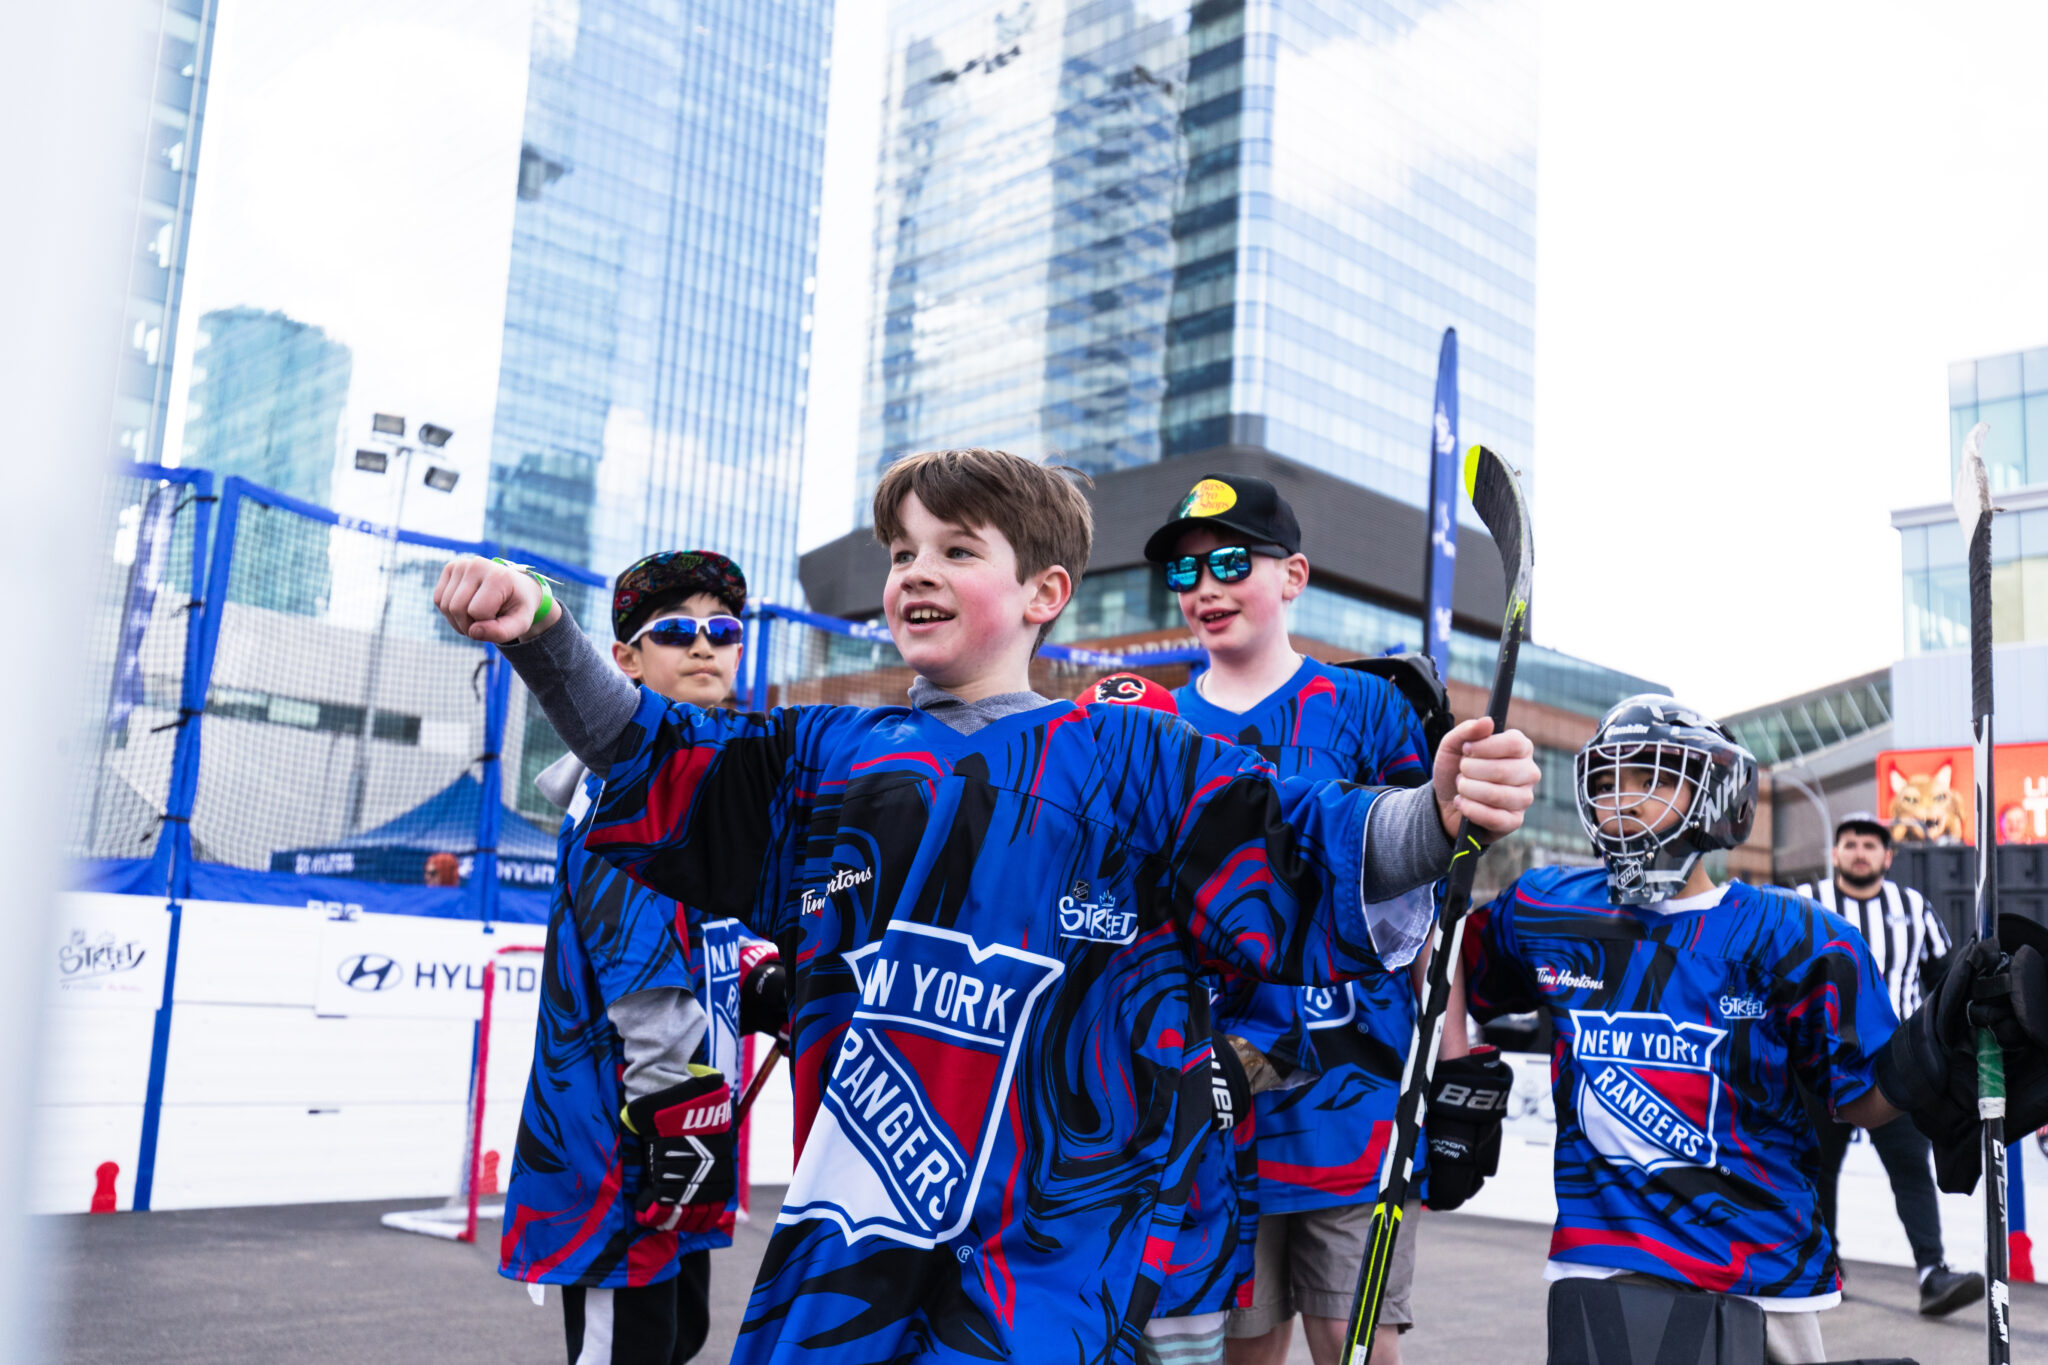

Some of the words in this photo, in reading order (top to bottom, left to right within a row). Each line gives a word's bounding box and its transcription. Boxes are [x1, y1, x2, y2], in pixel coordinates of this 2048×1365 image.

[1703, 752, 1749, 833] NHL
[801, 889, 826, 916] Tim
[826, 866, 873, 896] ortons
[1620, 866, 1638, 885] NHL
[1059, 896, 1138, 938] STREET
[913, 963, 1016, 1034] YORK
[1535, 967, 1556, 985] Tim
[1556, 968, 1604, 990] Hortons
[1719, 995, 1764, 1017] STREET
[1582, 1029, 1633, 1057] NEW
[831, 1026, 959, 1222] RANGERS
[1593, 1065, 1704, 1158] RANGERS
